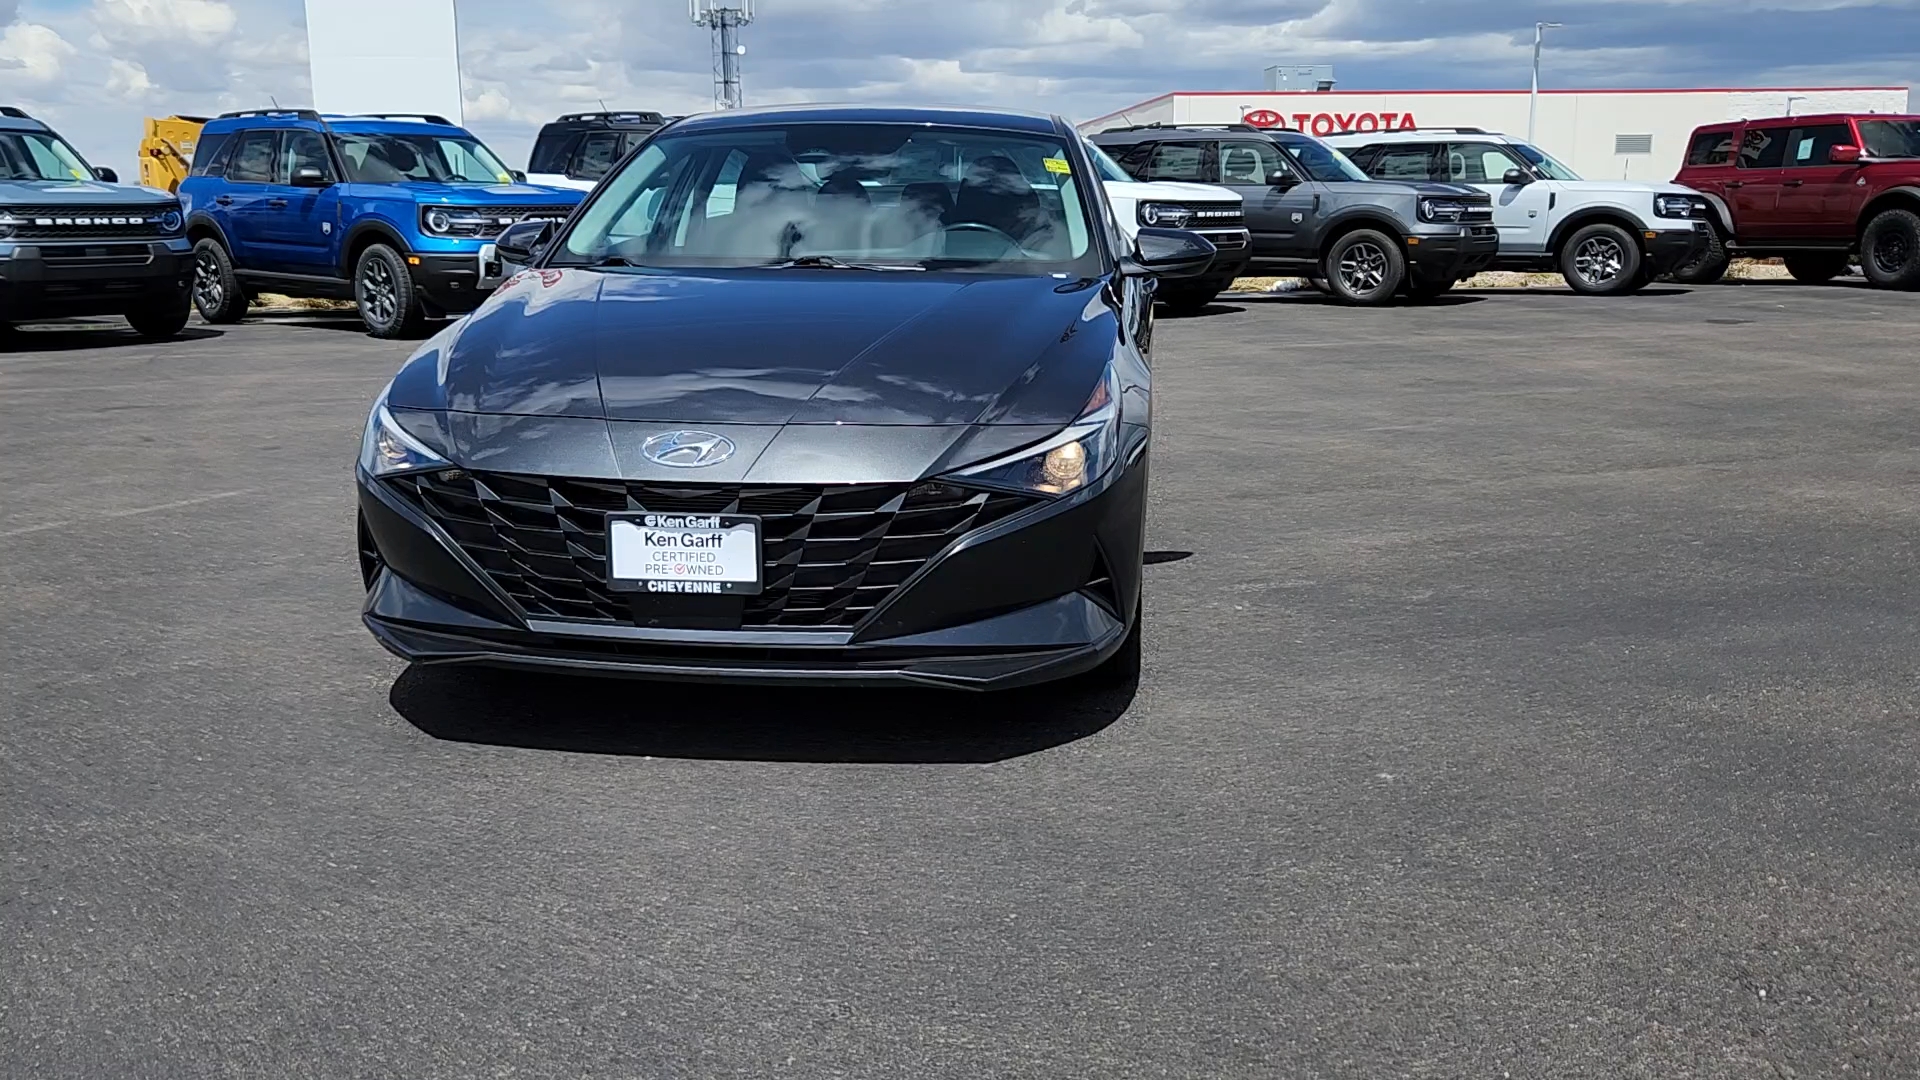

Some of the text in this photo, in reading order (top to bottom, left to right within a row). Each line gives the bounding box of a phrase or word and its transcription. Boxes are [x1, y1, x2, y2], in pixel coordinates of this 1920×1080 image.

[1292, 113, 1417, 137] TOYOTA
[35, 217, 144, 226] BRONCO
[644, 532, 723, 548] Ken Garff
[652, 551, 716, 563] CERTIFIED
[647, 580, 722, 594] CHEYENNE
